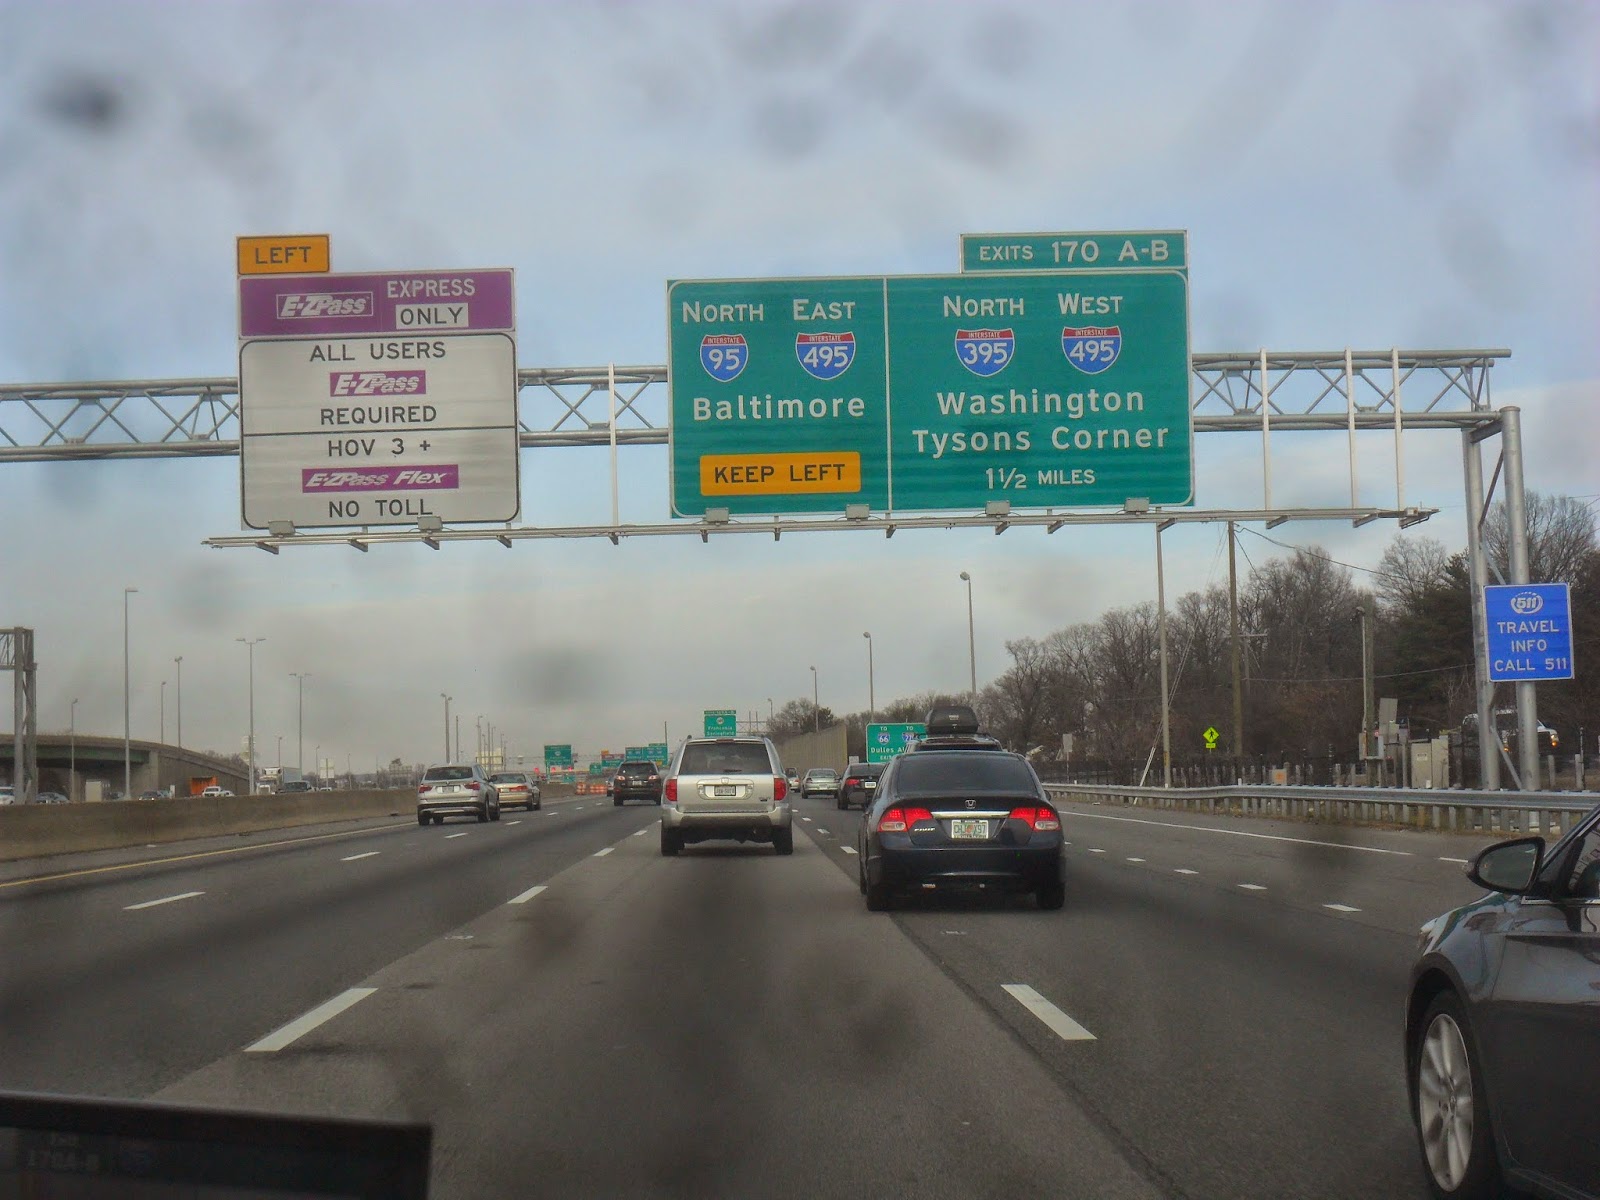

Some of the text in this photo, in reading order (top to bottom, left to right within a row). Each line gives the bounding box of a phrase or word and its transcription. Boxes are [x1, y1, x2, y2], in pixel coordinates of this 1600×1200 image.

[255, 246, 311, 264] LEFT
[980, 240, 1169, 262] EXITS 170 A-B
[387, 279, 476, 298] EXPRESS
[280, 294, 368, 316] E-ZPass
[682, 299, 855, 323] NORTH EAST
[943, 293, 1123, 317] NORTH WEST
[400, 308, 463, 325] ONLY
[310, 342, 446, 362] ALL USERS
[708, 349, 740, 370] 95
[803, 346, 848, 368] 495
[964, 342, 1008, 365] 395
[1070, 340, 1114, 362] 495
[334, 373, 420, 395] E-ZPass
[694, 395, 865, 421] Baltimore
[937, 388, 1144, 419] Washington
[320, 406, 437, 425] REQUIRED
[328, 439, 376, 457] HOV
[391, 438, 404, 455] 3
[912, 426, 1168, 458] Tysons Corner
[306, 470, 447, 488] E-ZPass Flex
[715, 464, 845, 483] KEEP LEFT
[1038, 470, 1096, 485] MILES
[329, 499, 433, 517] NO TOLL
[1517, 598, 1537, 608] 511
[1497, 620, 1559, 633] TRAVEL
[1511, 640, 1547, 652] INFO
[1495, 658, 1567, 672] CALL 511
